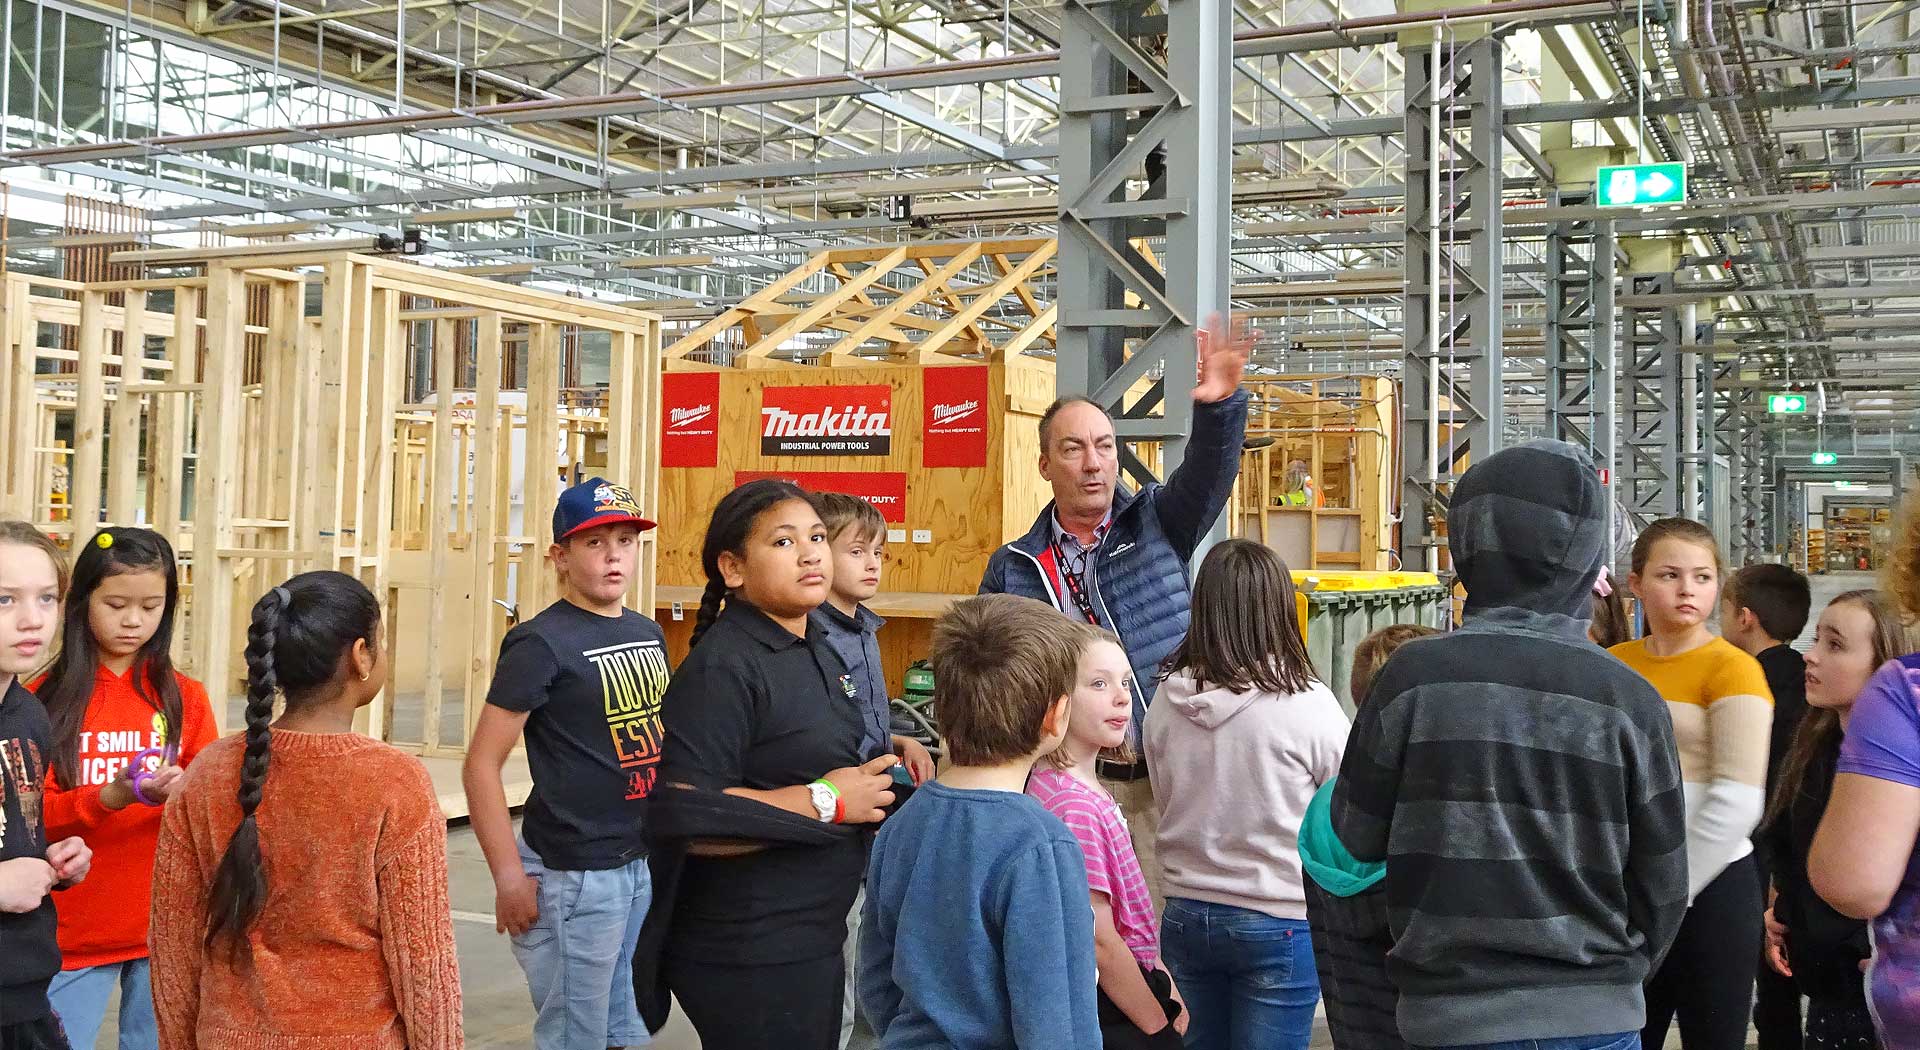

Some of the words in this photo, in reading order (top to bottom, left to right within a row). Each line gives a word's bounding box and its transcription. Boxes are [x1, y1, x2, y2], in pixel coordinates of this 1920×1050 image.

[932, 400, 979, 420] Milwaukee
[780, 442, 820, 450] INDUSTRIAL
[821, 442, 846, 450] POWER
[847, 442, 870, 450] TOOLS
